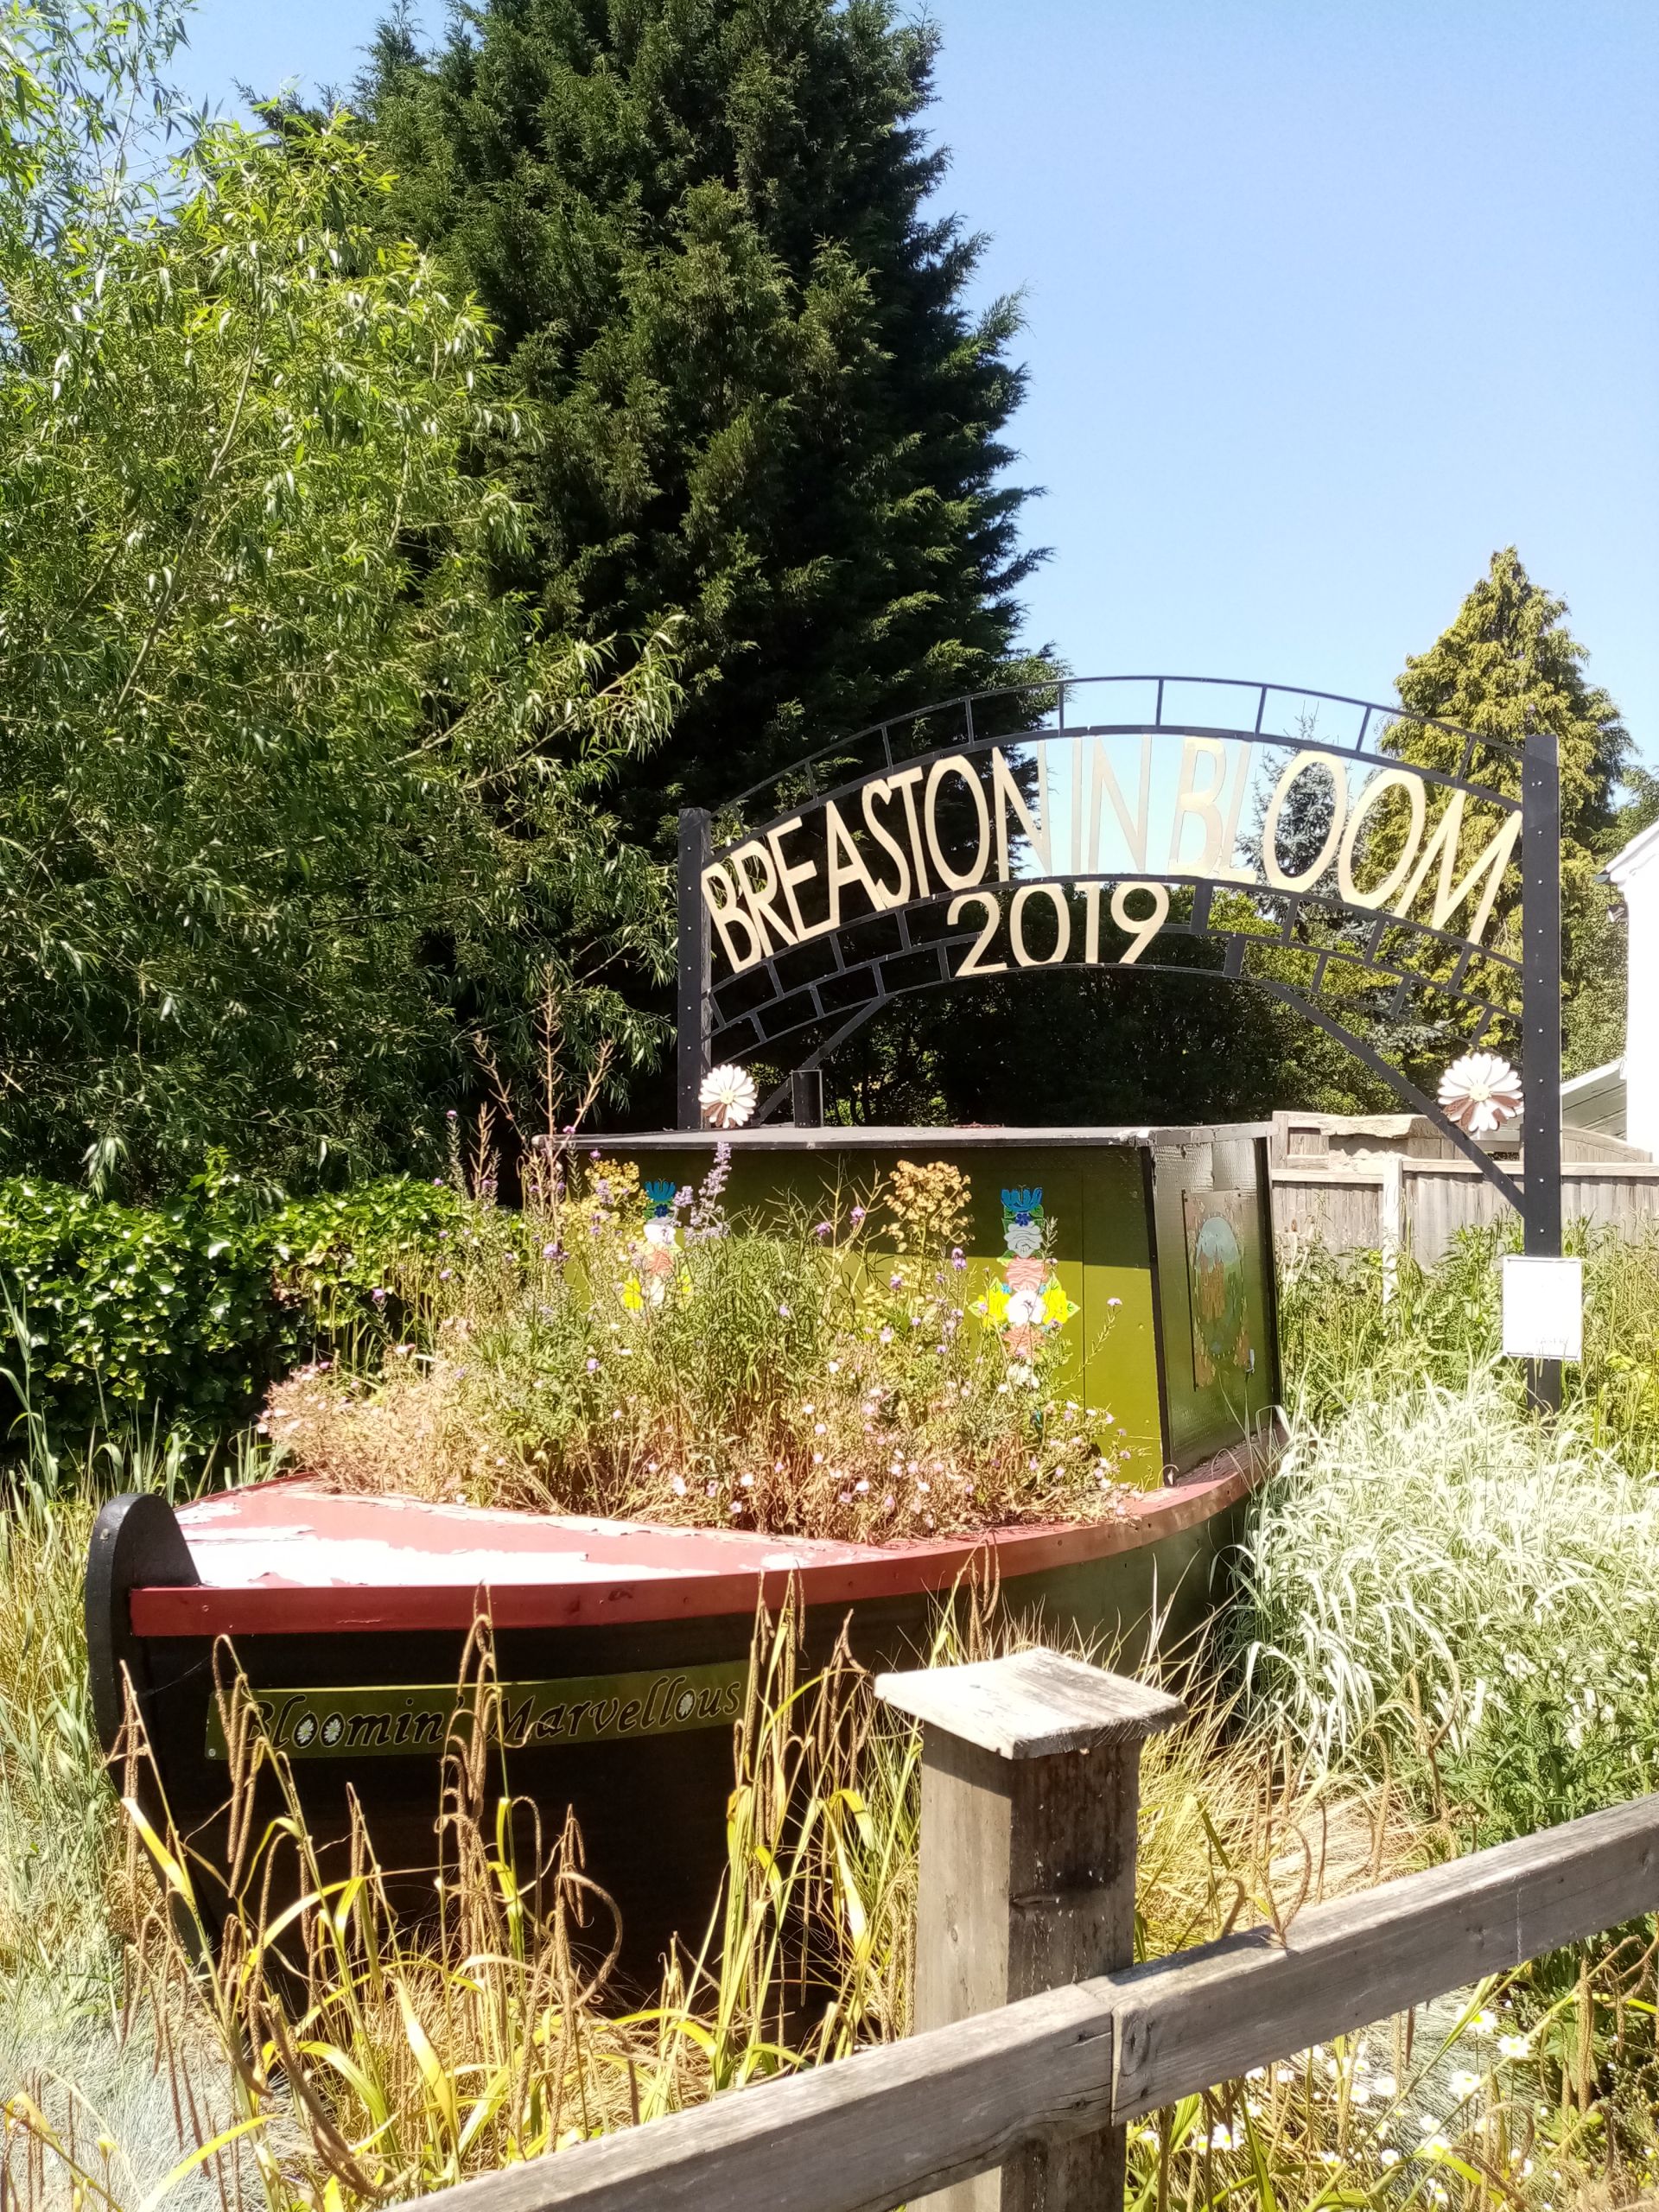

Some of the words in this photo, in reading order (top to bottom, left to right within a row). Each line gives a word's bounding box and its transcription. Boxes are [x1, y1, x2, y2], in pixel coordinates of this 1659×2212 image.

[702, 740, 1052, 974] BREASTON
[1071, 735, 1153, 874] IN
[1170, 737, 1523, 944] BLOOM
[947, 882, 1169, 977] 2019
[486, 1675, 741, 1742] Marvellous
